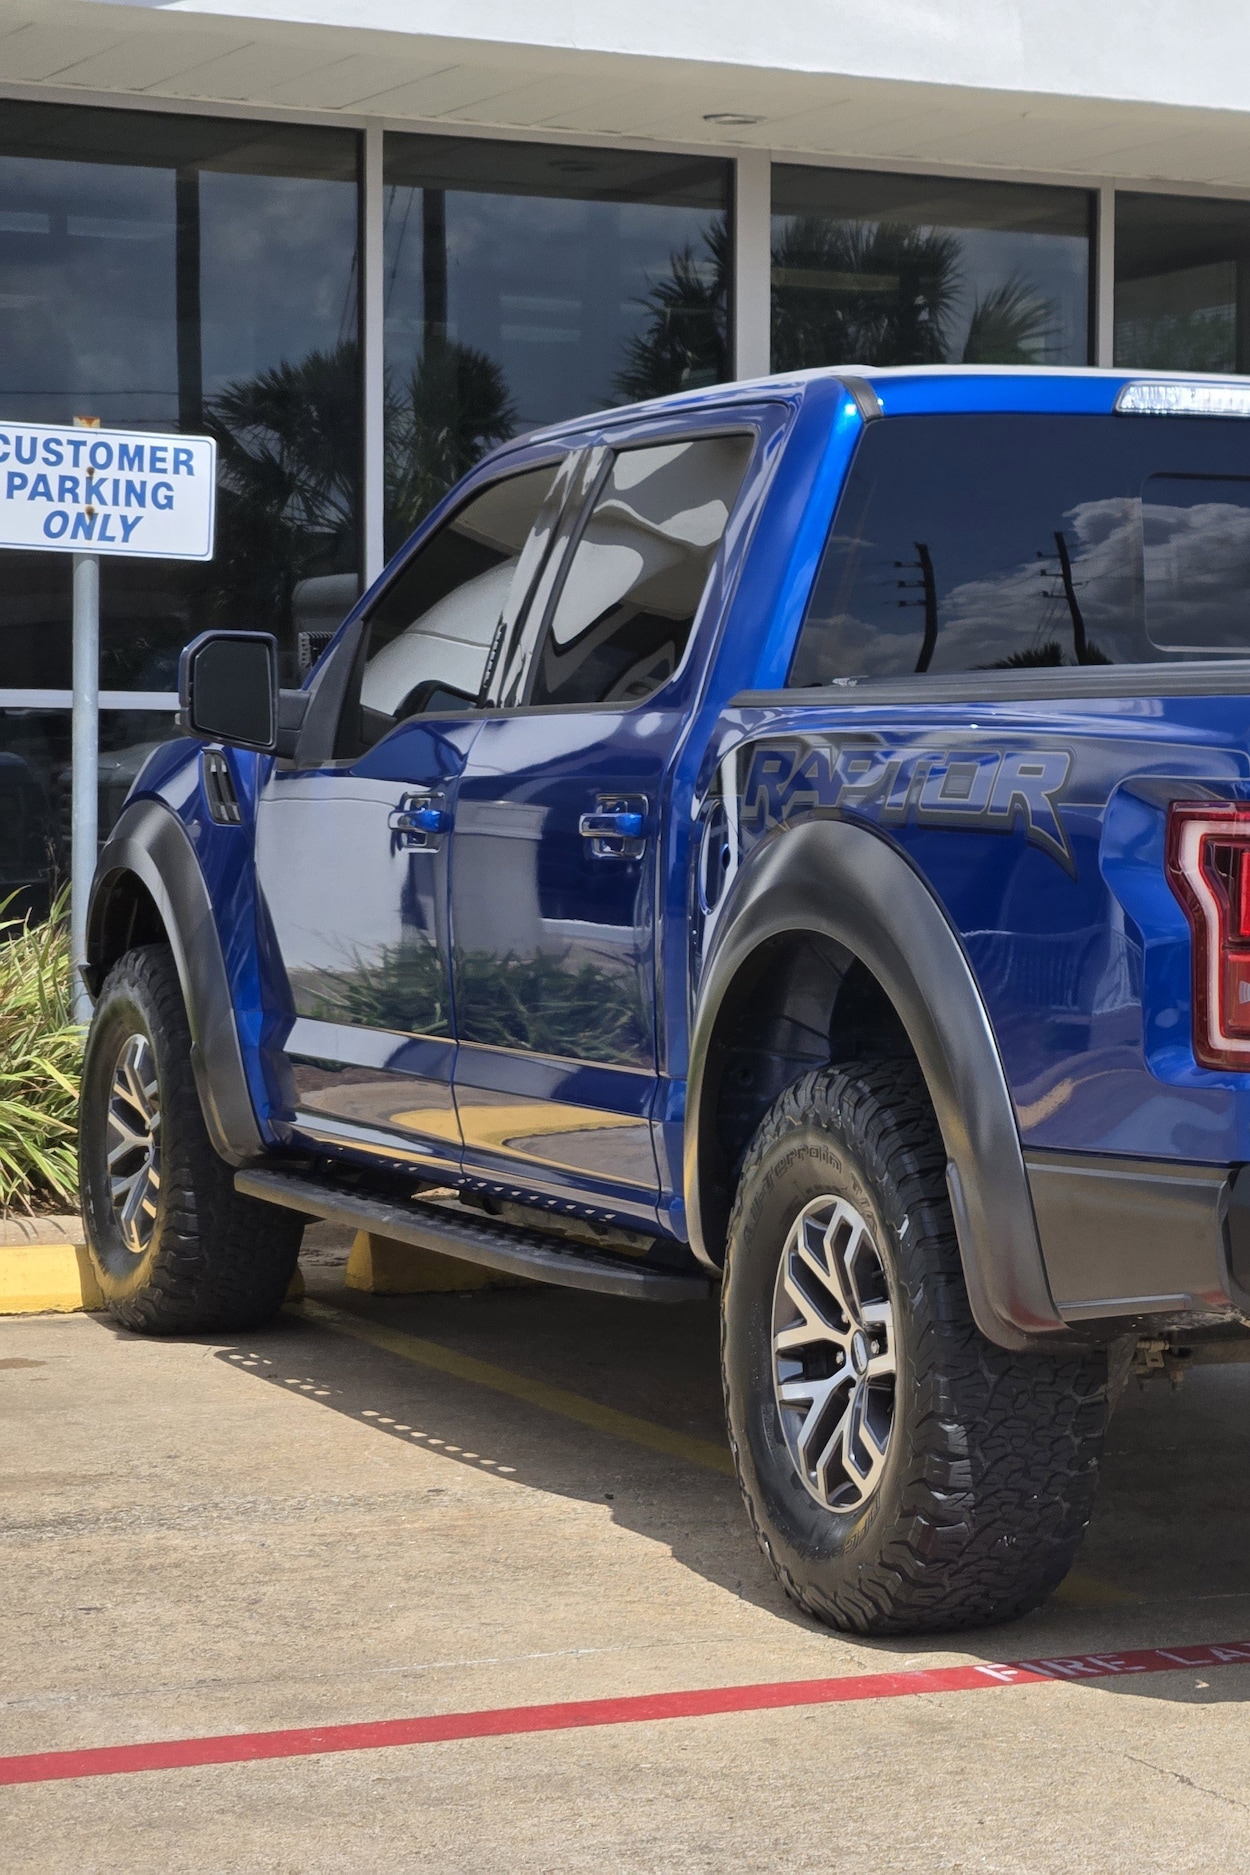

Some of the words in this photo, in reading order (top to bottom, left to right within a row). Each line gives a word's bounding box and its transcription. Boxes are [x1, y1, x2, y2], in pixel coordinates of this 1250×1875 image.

[6, 471, 175, 510] PARKING
[43, 510, 144, 543] ONLY
[741, 742, 1078, 884] RAPTOR
[973, 1653, 1146, 1683] FIRE
